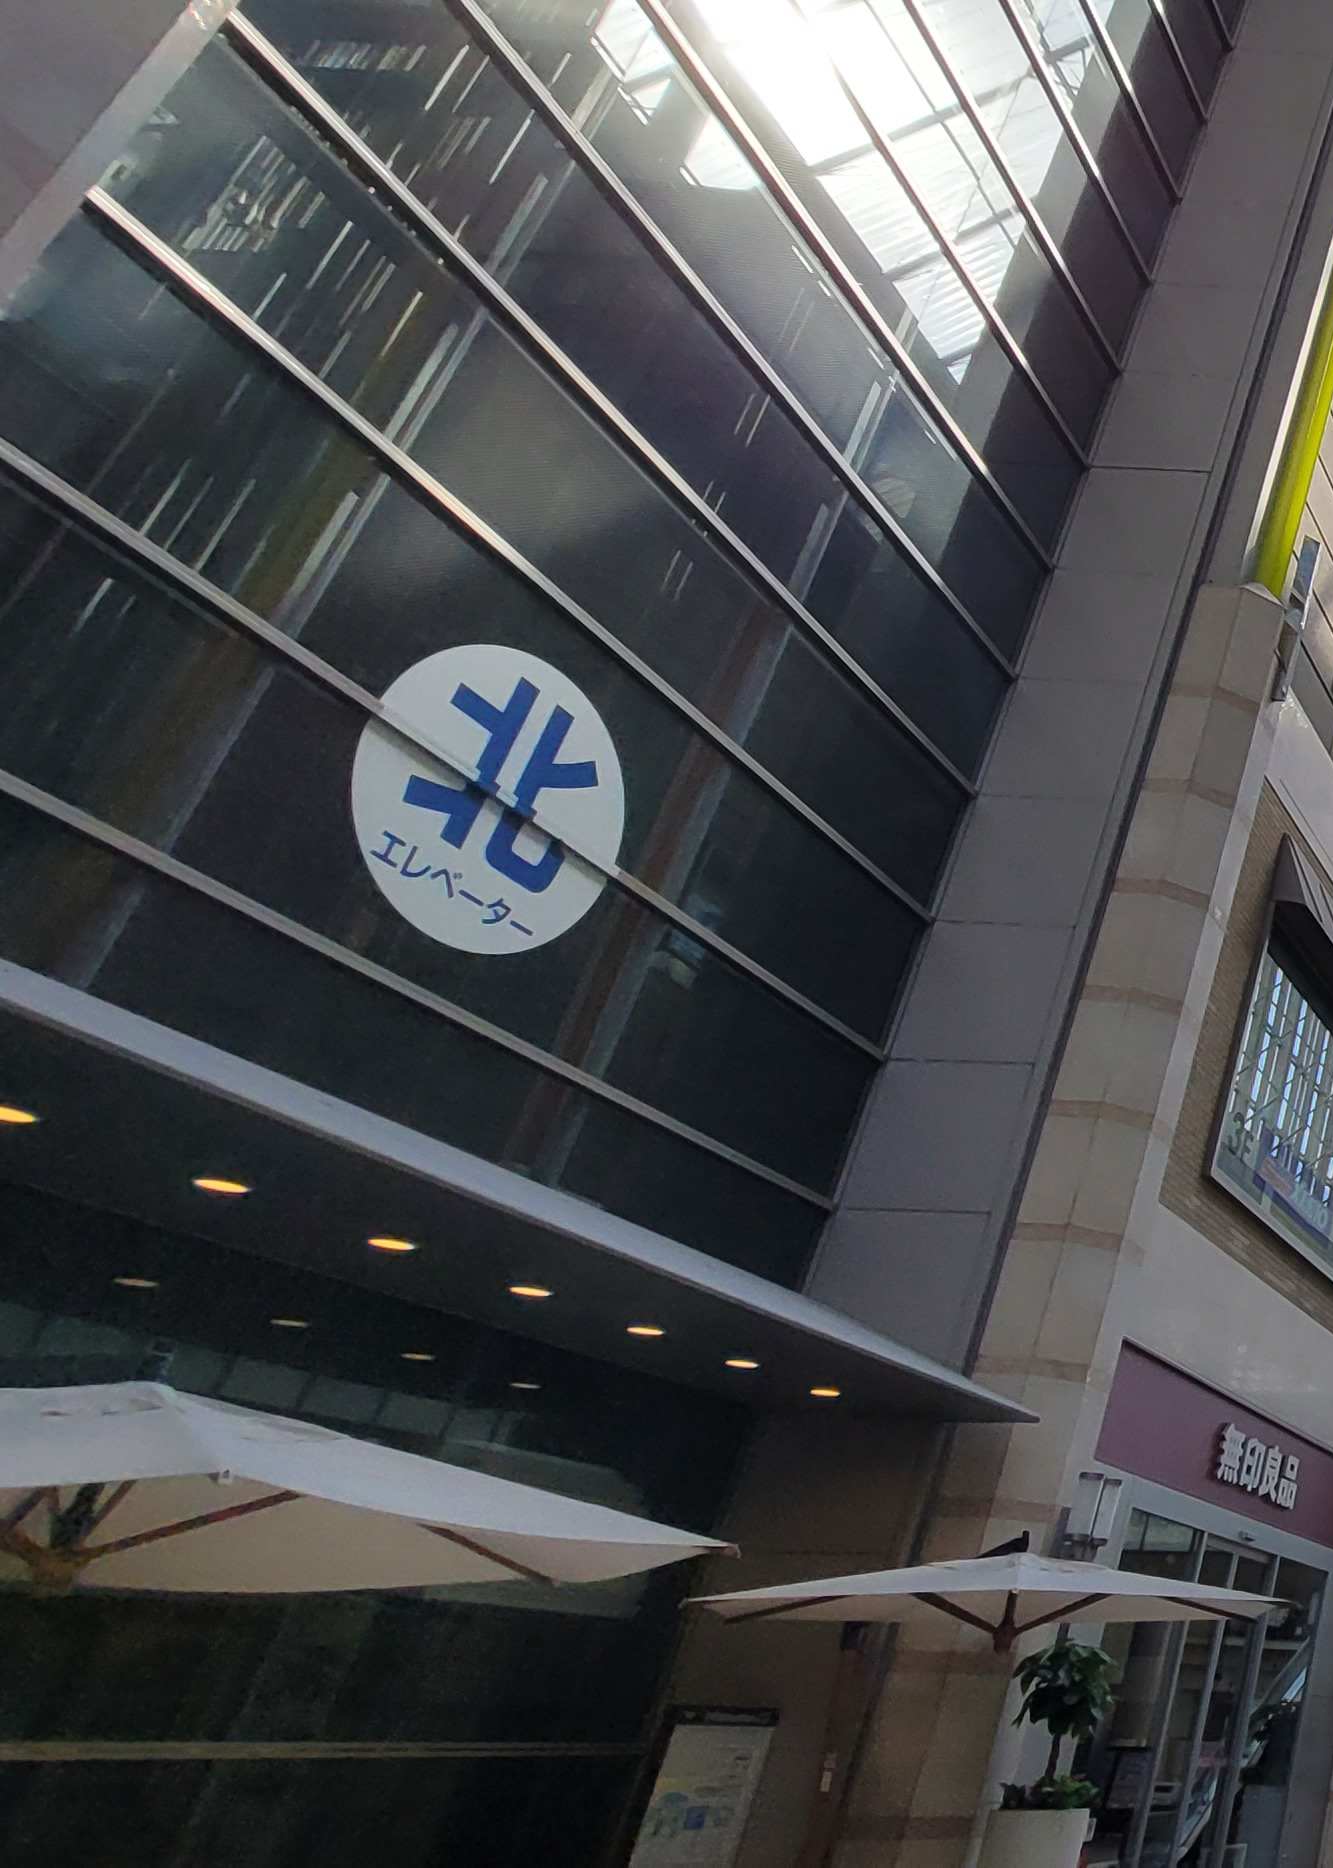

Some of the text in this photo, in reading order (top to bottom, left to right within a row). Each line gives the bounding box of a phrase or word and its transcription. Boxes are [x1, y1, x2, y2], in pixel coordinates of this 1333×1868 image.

[402, 676, 599, 893] 北
[370, 830, 534, 936] エレベーター
[1216, 1423, 1300, 1510] 無印良品
